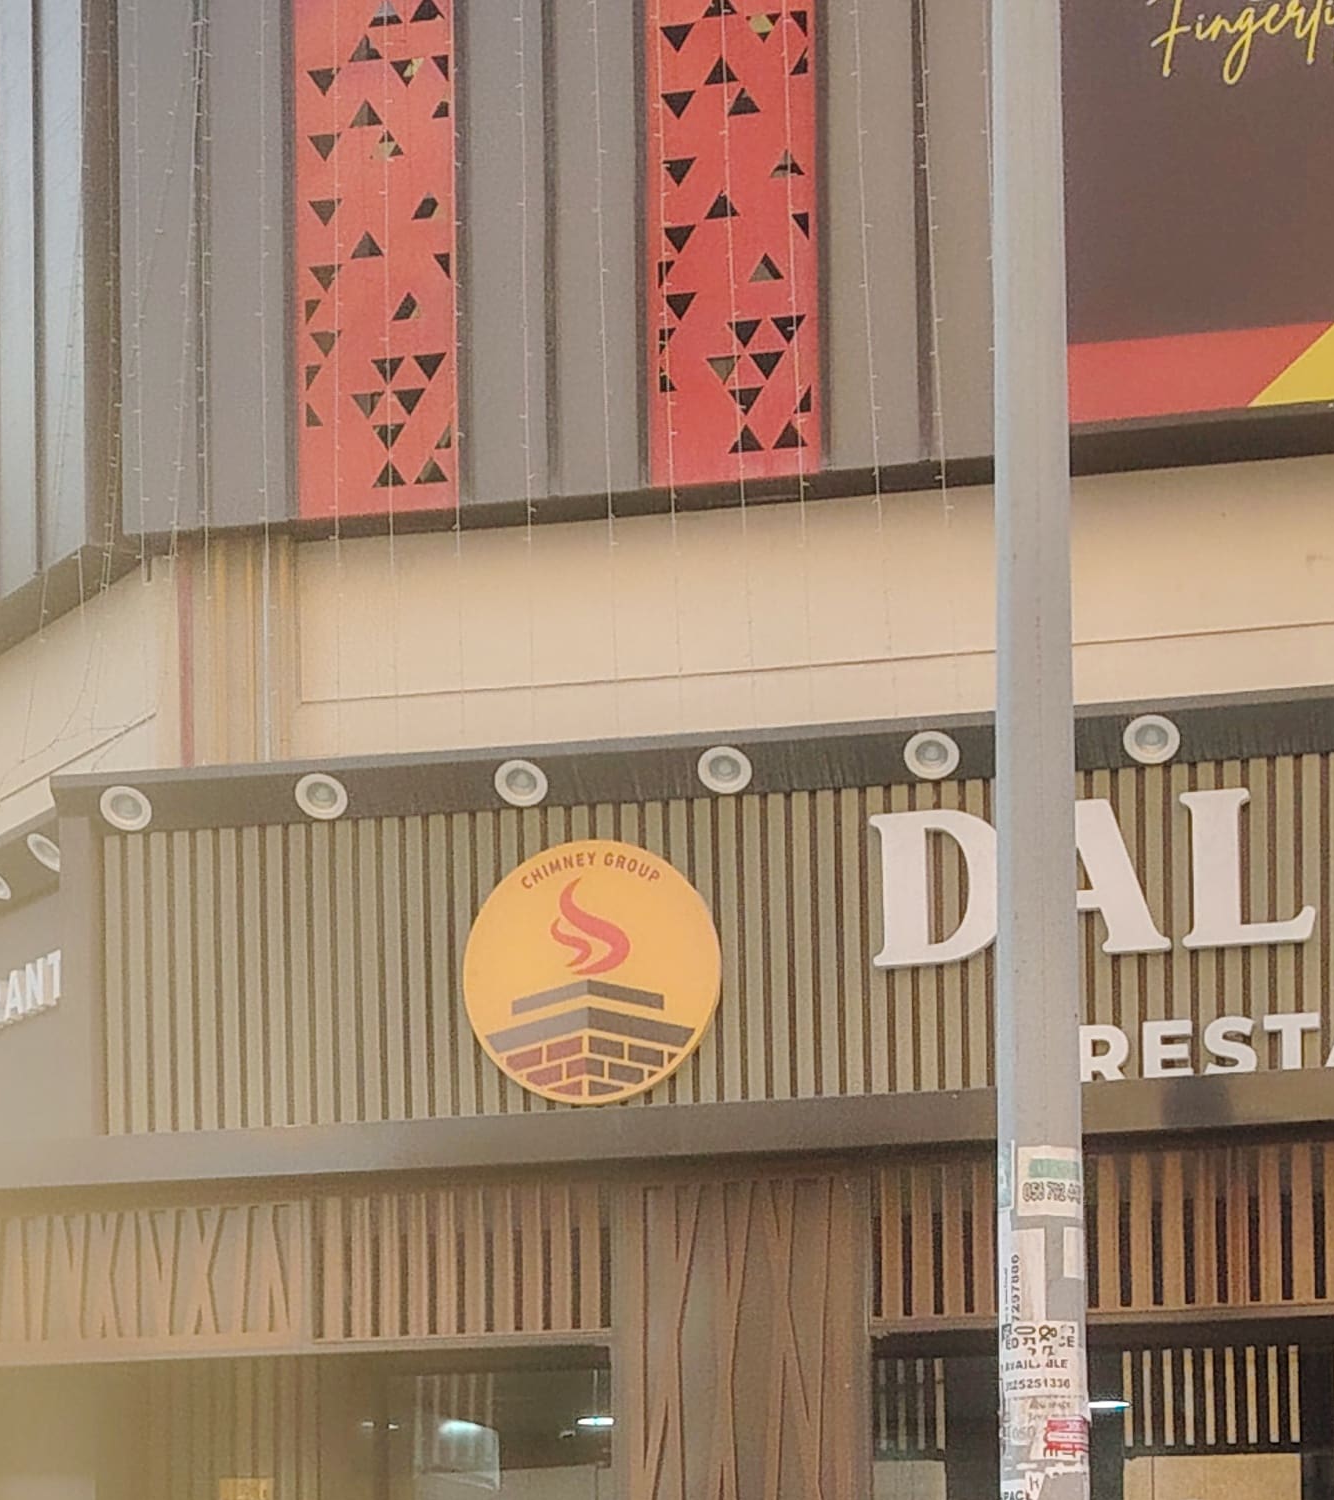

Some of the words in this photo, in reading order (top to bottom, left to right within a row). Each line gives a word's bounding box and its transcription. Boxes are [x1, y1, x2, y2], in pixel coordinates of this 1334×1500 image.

[521, 851, 596, 890] CHIMNEY
[604, 852, 660, 883] GROUP
[869, 787, 1316, 969] DAL
